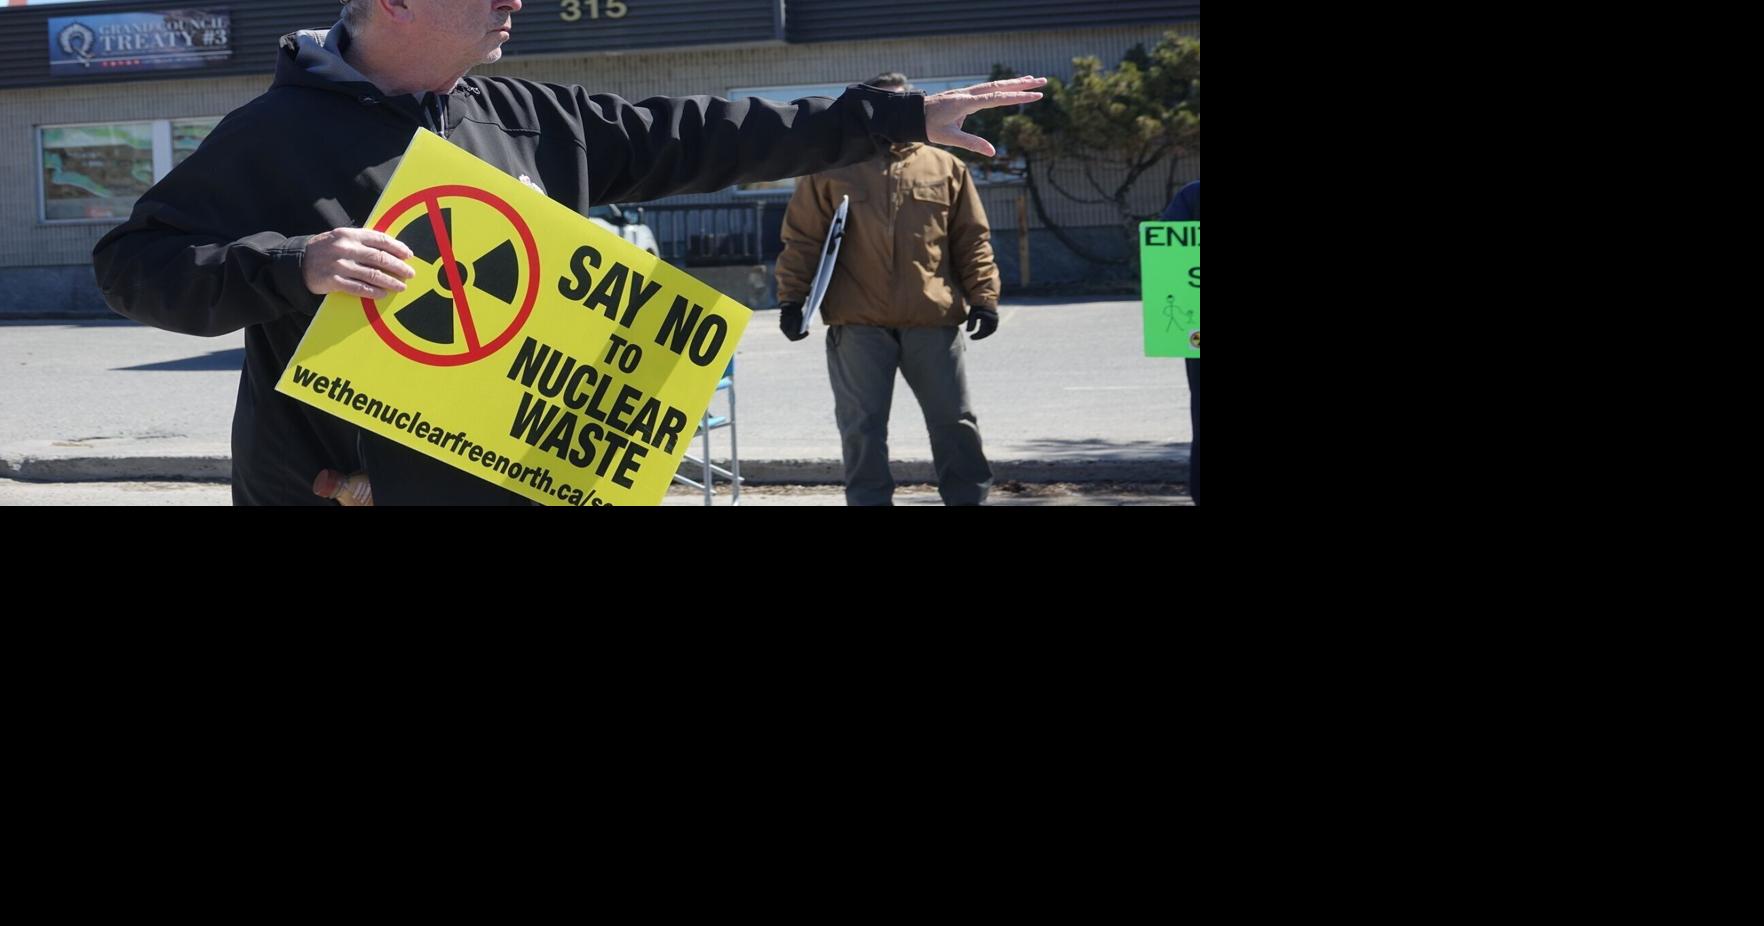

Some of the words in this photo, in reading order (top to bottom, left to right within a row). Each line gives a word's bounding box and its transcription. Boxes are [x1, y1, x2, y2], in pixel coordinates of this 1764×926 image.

[100, 22, 154, 34] GRAND
[156, 17, 224, 31] COUNCIL
[560, 0, 627, 21] 315
[100, 31, 195, 51] TREATY
[203, 29, 228, 46] #3
[1145, 226, 1200, 246] ENI
[558, 245, 662, 329] SAY
[655, 294, 728, 367] NO
[604, 334, 643, 374] TO
[506, 336, 688, 455] NUCLEAR
[292, 365, 613, 506] wethenuclearfreenorth.ca/s
[509, 391, 649, 490] WASTE
